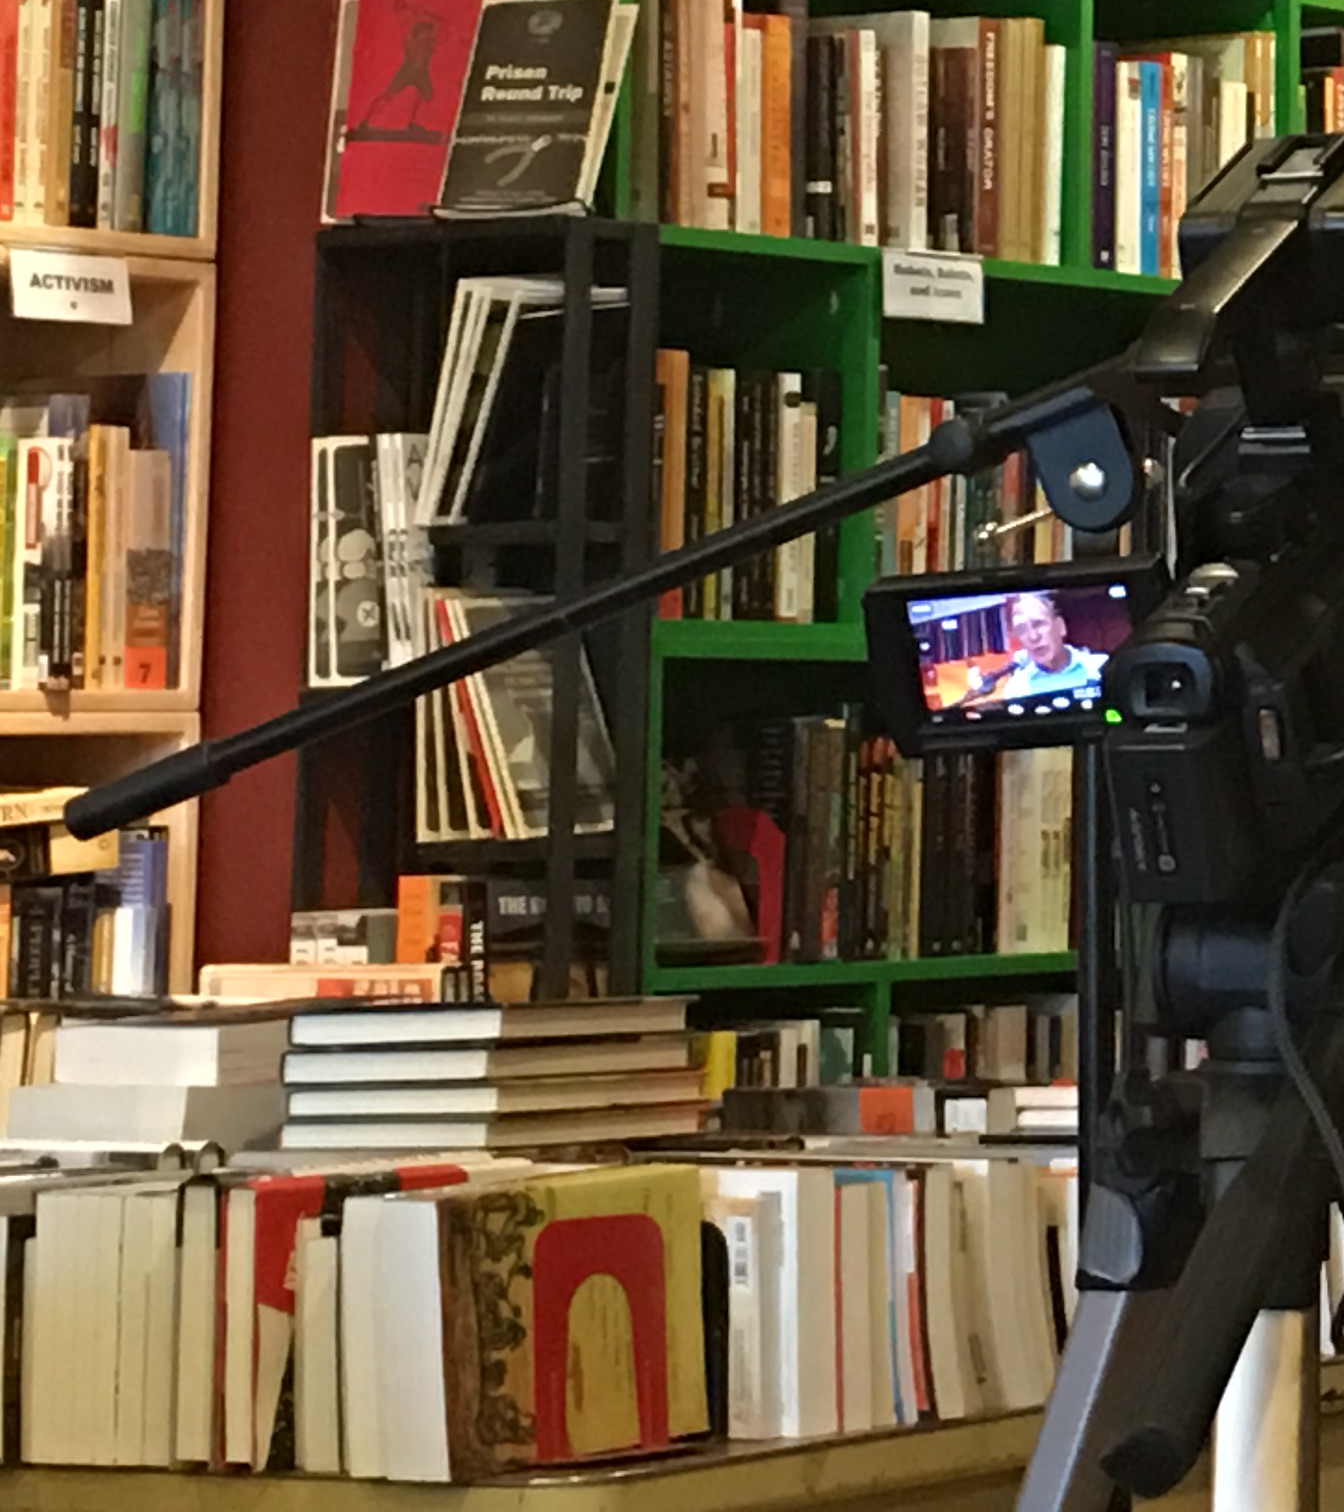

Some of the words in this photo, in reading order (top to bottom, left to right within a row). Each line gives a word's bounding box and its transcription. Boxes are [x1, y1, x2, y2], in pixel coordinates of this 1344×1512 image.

[485, 65, 548, 80] Prison
[985, 32, 996, 120] FREEDOM'S
[480, 86, 543, 102] Round
[548, 85, 583, 103] Trip
[983, 127, 994, 190] ORATOR
[29, 272, 115, 296] ACTIVISM
[138, 663, 152, 684] 7
[499, 895, 527, 916] THE
[470, 919, 485, 954] THE
